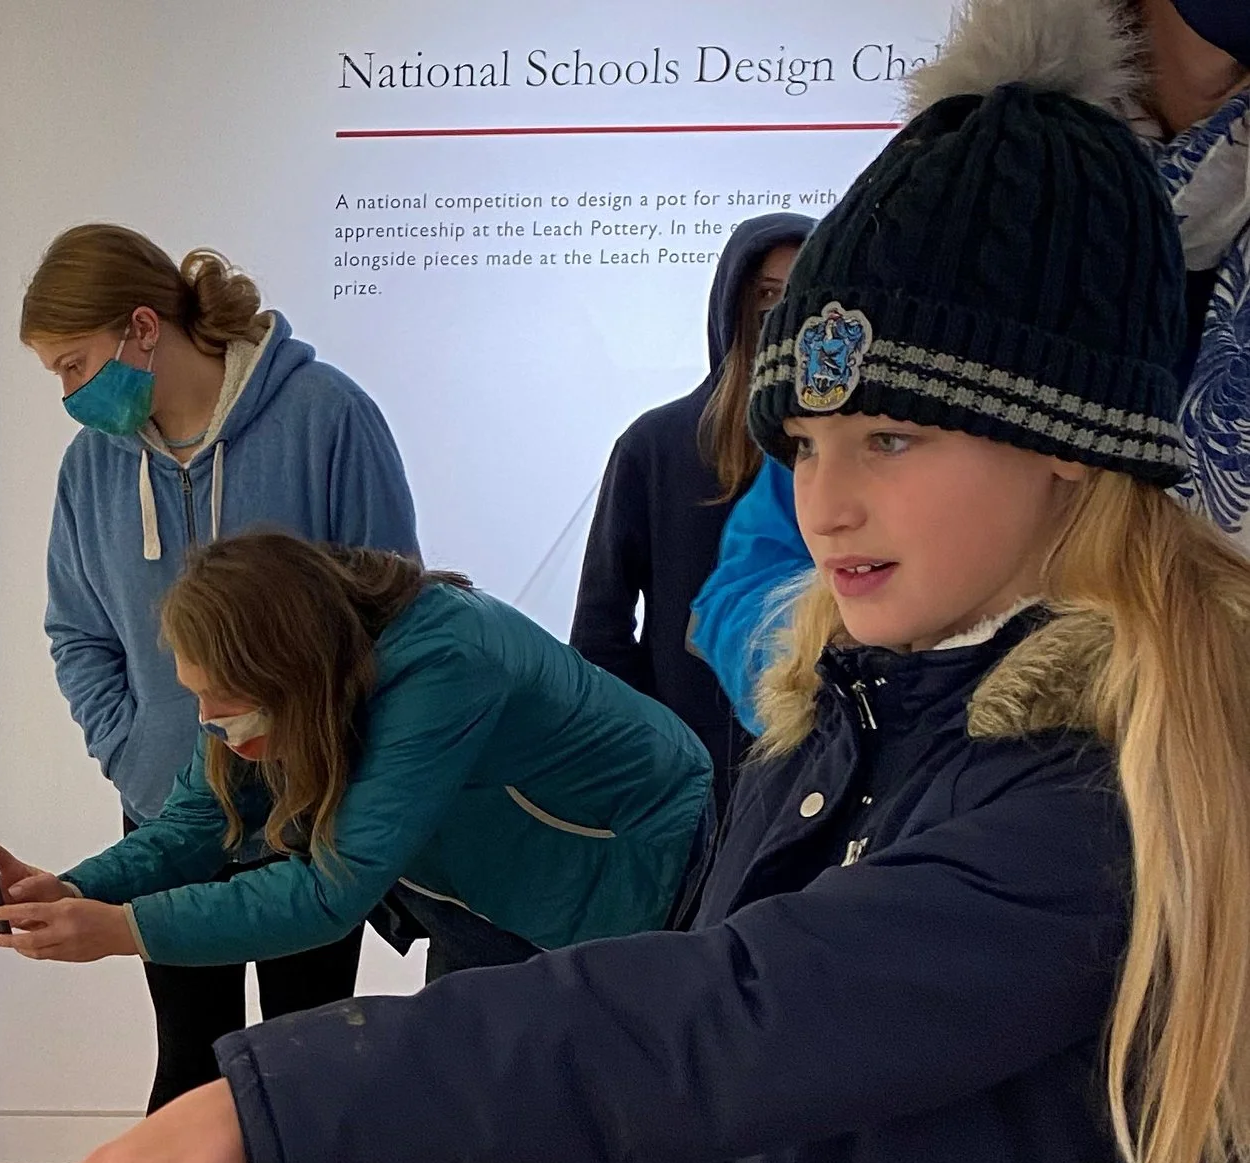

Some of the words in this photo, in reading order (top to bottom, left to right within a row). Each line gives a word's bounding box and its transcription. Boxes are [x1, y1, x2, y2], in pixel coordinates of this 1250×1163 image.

[338, 49, 511, 89] National
[525, 47, 679, 87] Schools
[694, 46, 835, 96] Design
[336, 194, 349, 210] A
[357, 193, 427, 209] national
[435, 193, 542, 213] competition
[551, 195, 569, 207] to
[577, 192, 631, 211] design
[640, 195, 648, 207] a
[656, 193, 686, 211] pot
[694, 190, 720, 206] for
[727, 190, 791, 209] sharing
[799, 189, 836, 205] with
[335, 222, 465, 242] apprenticeship
[472, 224, 489, 237] at
[497, 221, 524, 236] the
[532, 220, 582, 236] Leach
[591, 221, 662, 239] Pottery.
[671, 220, 686, 235] In
[694, 219, 722, 234] the
[334, 251, 416, 270] alongside
[424, 252, 478, 270] pieces
[486, 250, 532, 266] made
[540, 252, 556, 265] at
[564, 249, 592, 265] the
[600, 248, 649, 264] Leach
[334, 280, 382, 300] prize.
